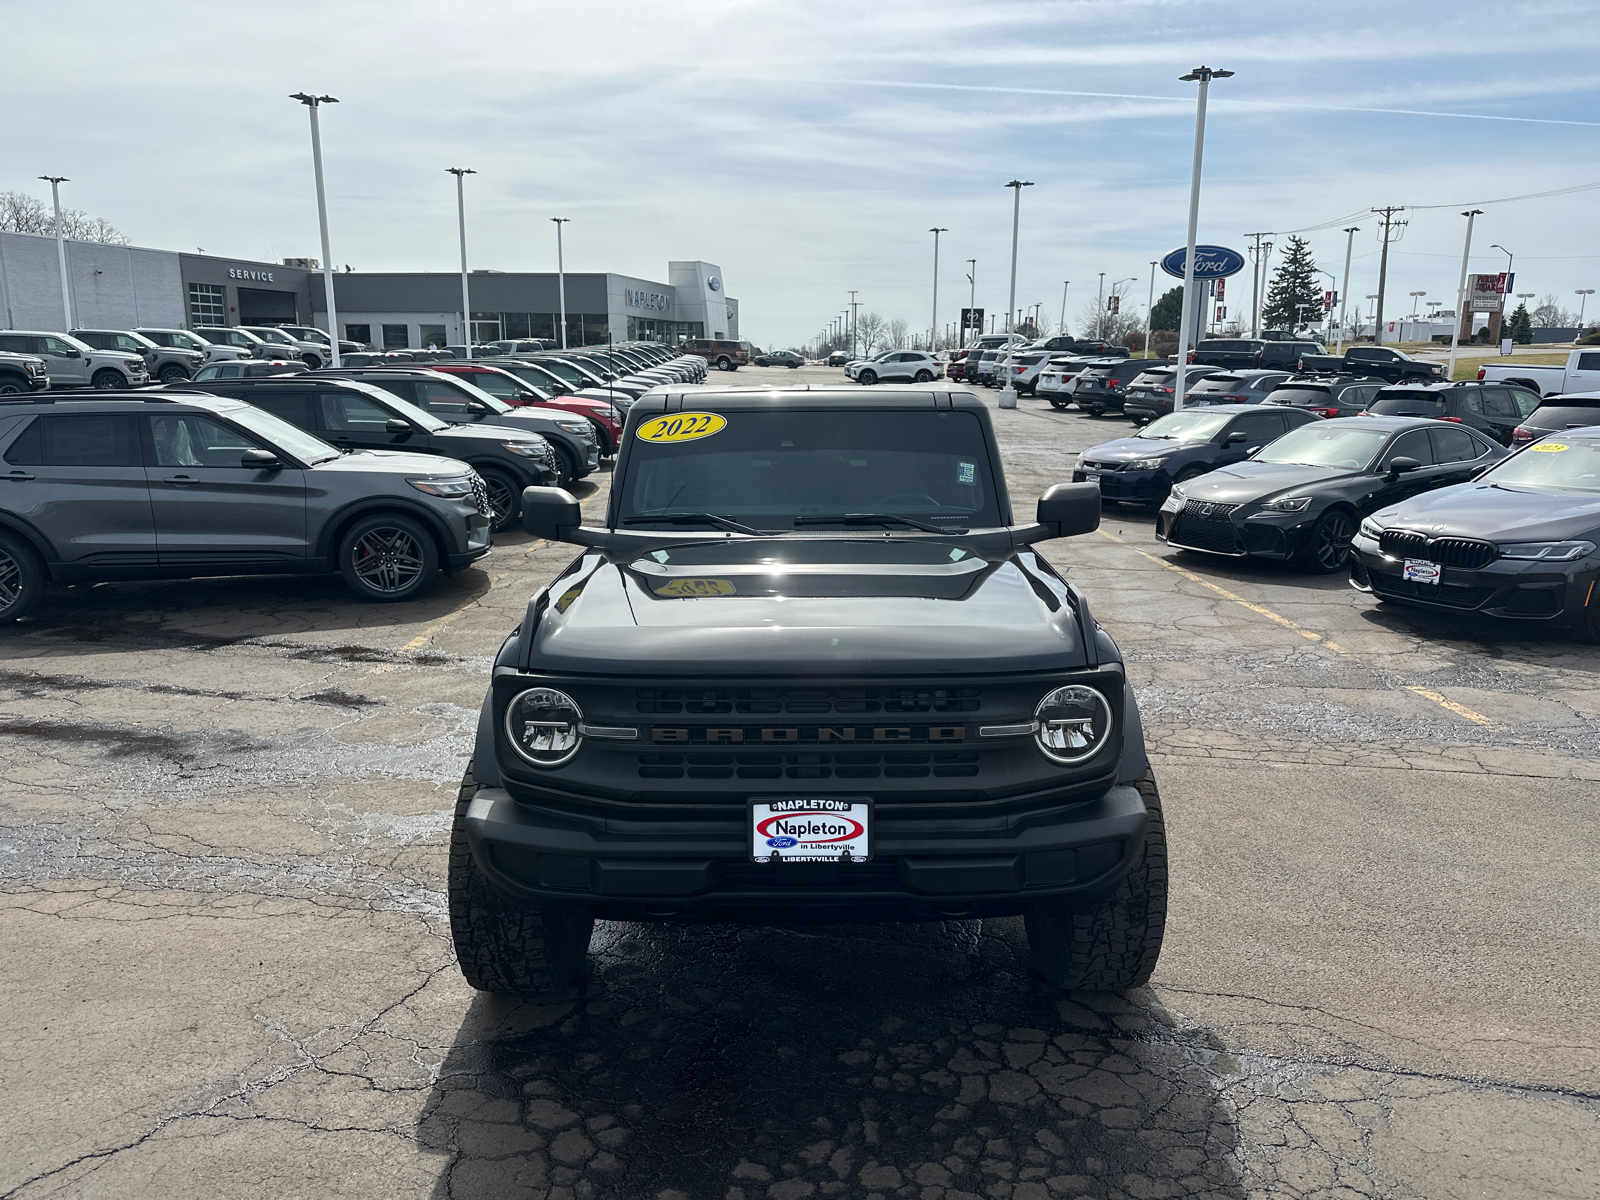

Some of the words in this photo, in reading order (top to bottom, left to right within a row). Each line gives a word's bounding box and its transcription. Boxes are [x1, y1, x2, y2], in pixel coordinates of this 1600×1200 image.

[1180, 252, 1229, 272] Ford
[229, 268, 274, 282] SERVICE
[1475, 283, 1497, 292] SQUAR
[626, 288, 670, 311] NAPLETON
[651, 416, 711, 438] 2022
[1410, 567, 1434, 575] Napleton
[652, 727, 965, 740] BRONCO
[777, 800, 844, 811] NAPLETON
[776, 820, 847, 838] Napleton
[772, 838, 792, 847] Ford
[810, 843, 855, 851] Libertyville
